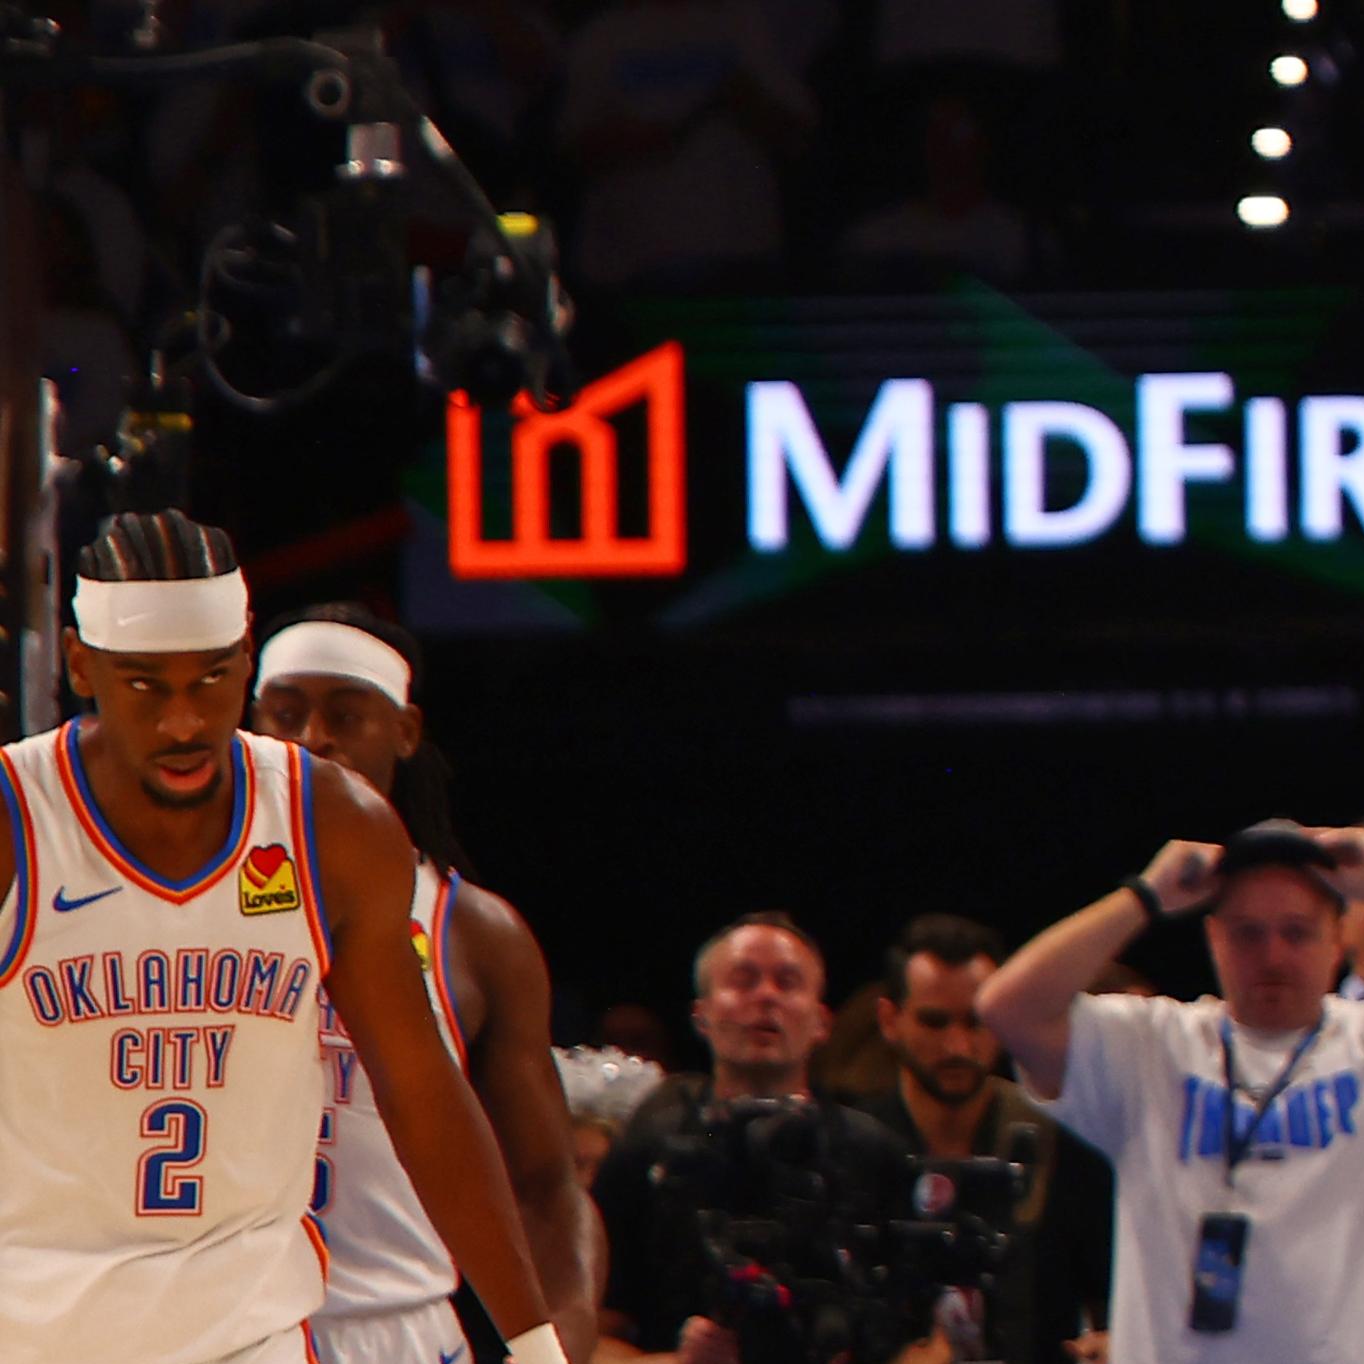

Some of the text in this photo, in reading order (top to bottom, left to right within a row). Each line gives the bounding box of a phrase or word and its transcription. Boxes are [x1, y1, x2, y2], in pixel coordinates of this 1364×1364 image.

[23, 948, 312, 1026] OKLAHOMA
[111, 1025, 235, 1090] CITY
[136, 1096, 208, 1217] 2
